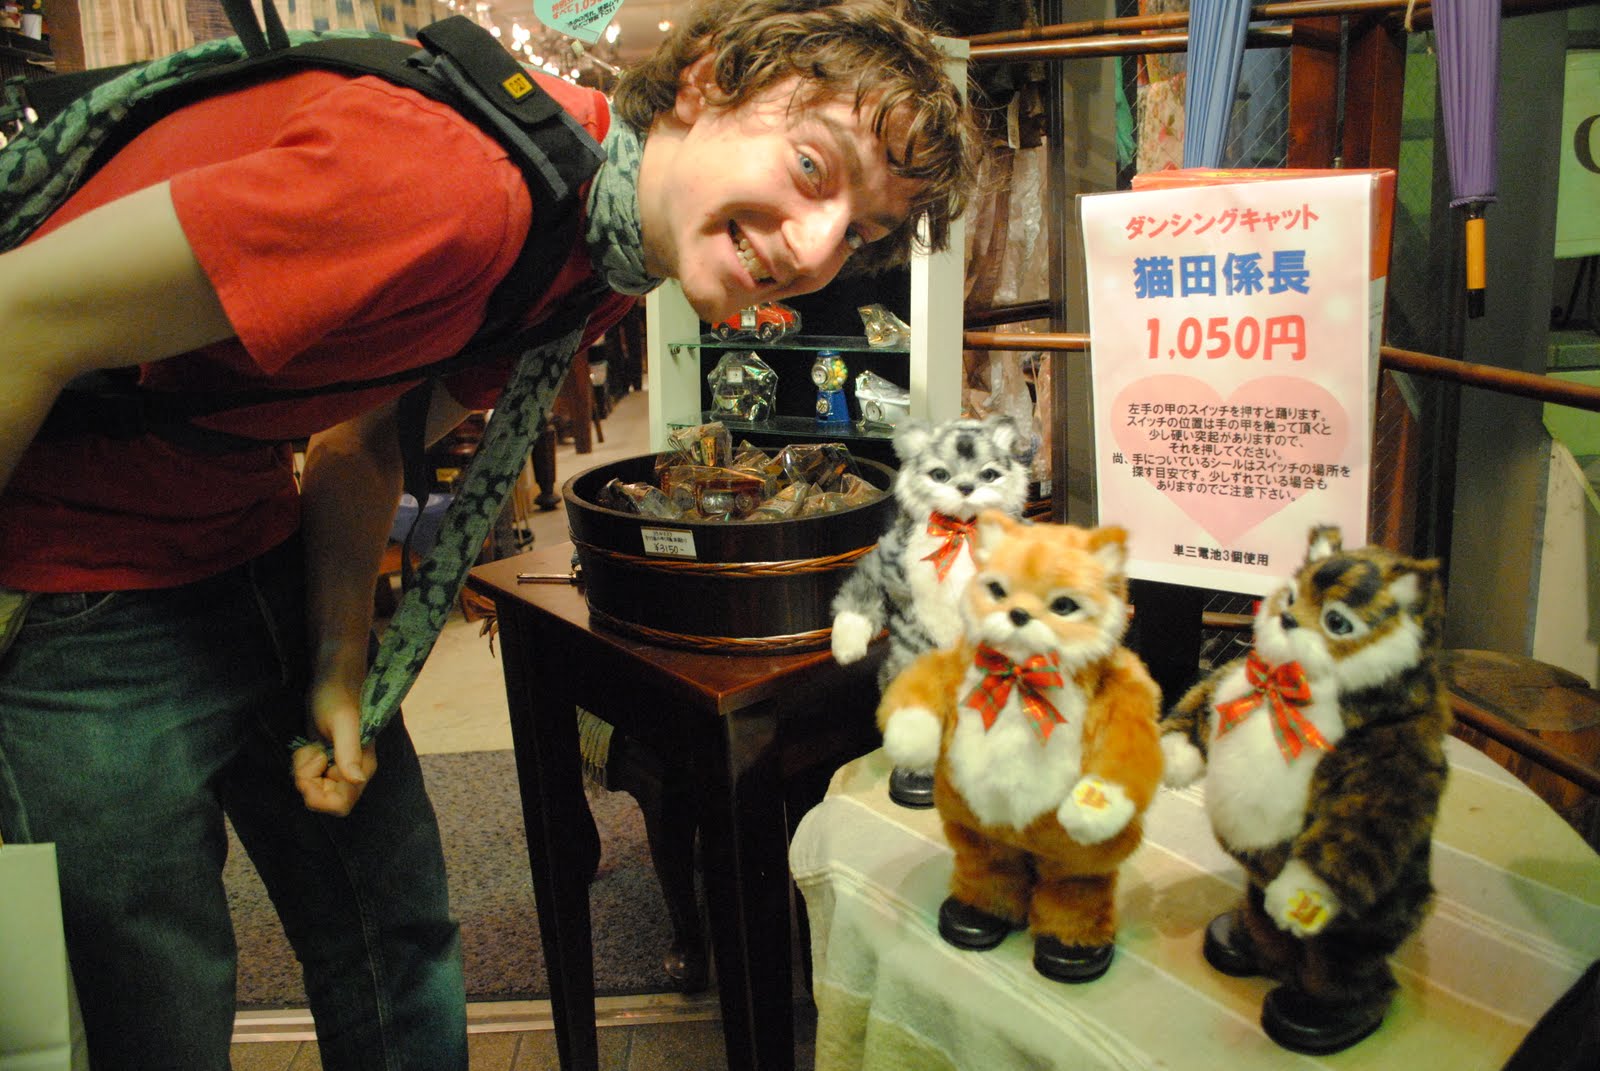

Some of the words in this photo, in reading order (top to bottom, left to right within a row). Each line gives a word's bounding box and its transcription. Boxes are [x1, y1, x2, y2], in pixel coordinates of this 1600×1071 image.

[1125, 203, 1320, 241] ダンシングキャット
[1132, 249, 1311, 299] 猫田係長
[1146, 314, 1307, 361] 1,050円
[1127, 403, 1326, 422] 左手の甲のスイッチを押すと踊ります。
[1126, 415, 1332, 436] スイッチの位置は手の甲を触って頂くと
[1148, 428, 1304, 448] 少し硬い突起がありますので、
[1168, 442, 1282, 461] それを押してください。
[1173, 543, 1269, 566] 単三電池3個使用
